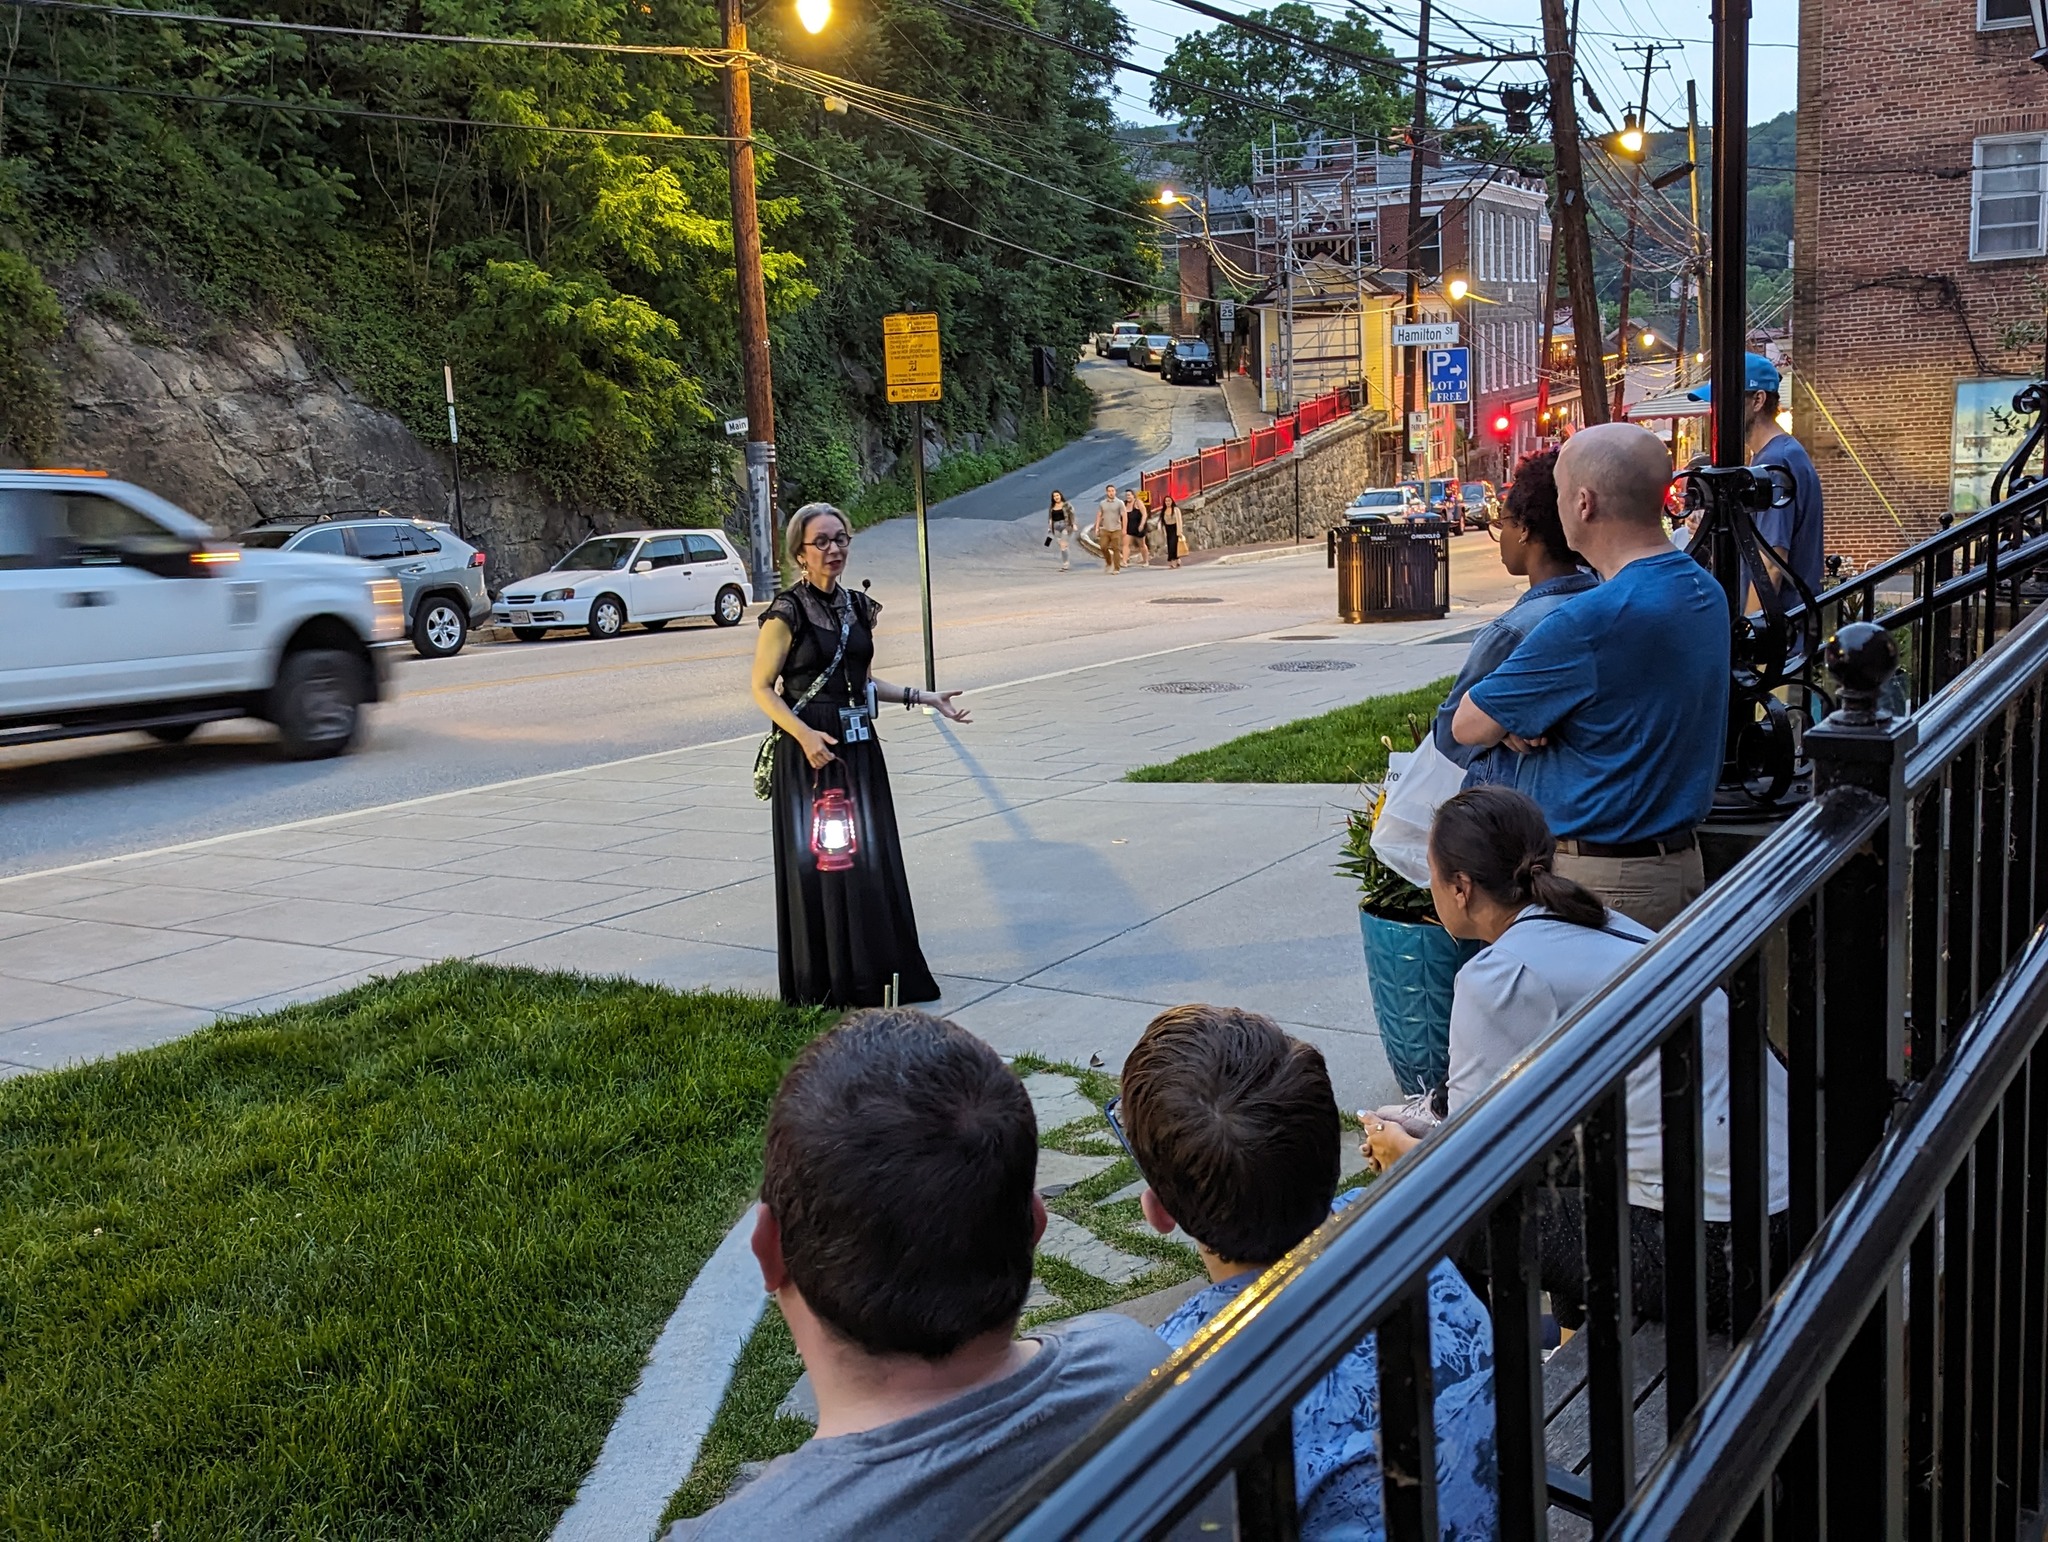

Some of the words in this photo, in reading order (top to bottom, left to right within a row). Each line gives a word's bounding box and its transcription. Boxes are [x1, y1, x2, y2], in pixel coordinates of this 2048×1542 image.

[1221, 309, 1233, 317] 25
[1398, 328, 1442, 342] Hamilton
[1445, 326, 1453, 335] St
[1432, 351, 1451, 376] P
[1431, 380, 1454, 391] LOT
[1459, 379, 1467, 390] D
[1437, 391, 1462, 402] FREE
[728, 421, 747, 432] Main
[1387, 771, 1402, 782] YO
